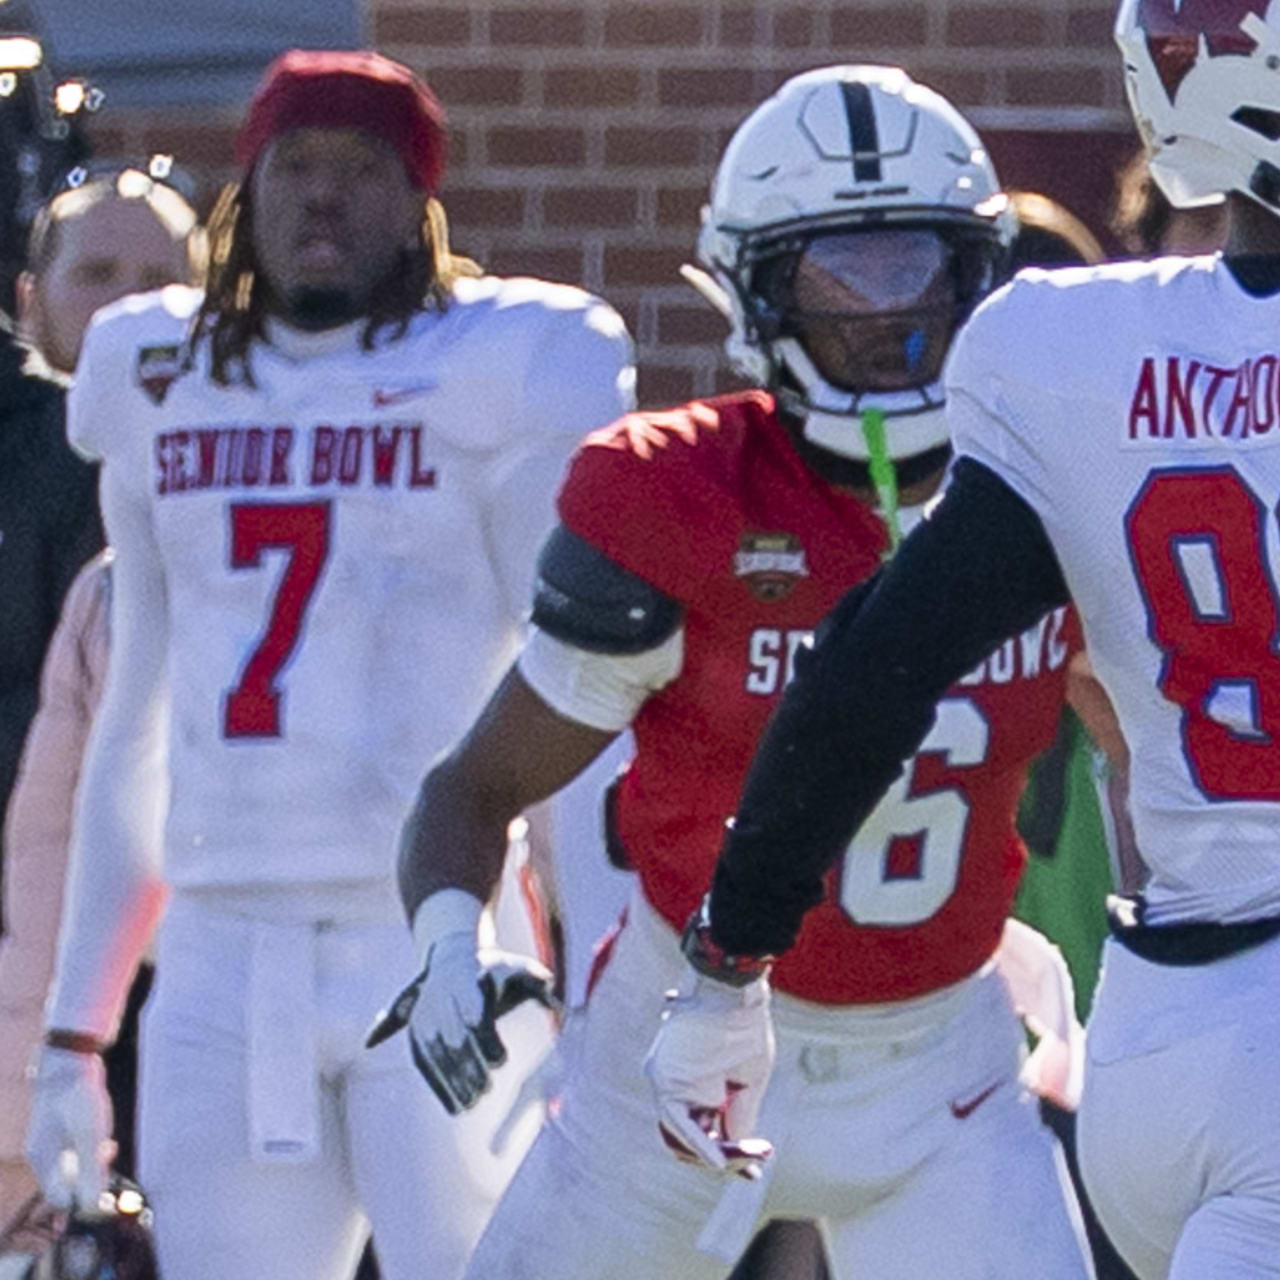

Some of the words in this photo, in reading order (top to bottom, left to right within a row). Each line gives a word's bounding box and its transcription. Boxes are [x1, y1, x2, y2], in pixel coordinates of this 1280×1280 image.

[309, 424, 438, 490] BOWL
[224, 500, 332, 738] 7
[837, 695, 990, 928] 6
